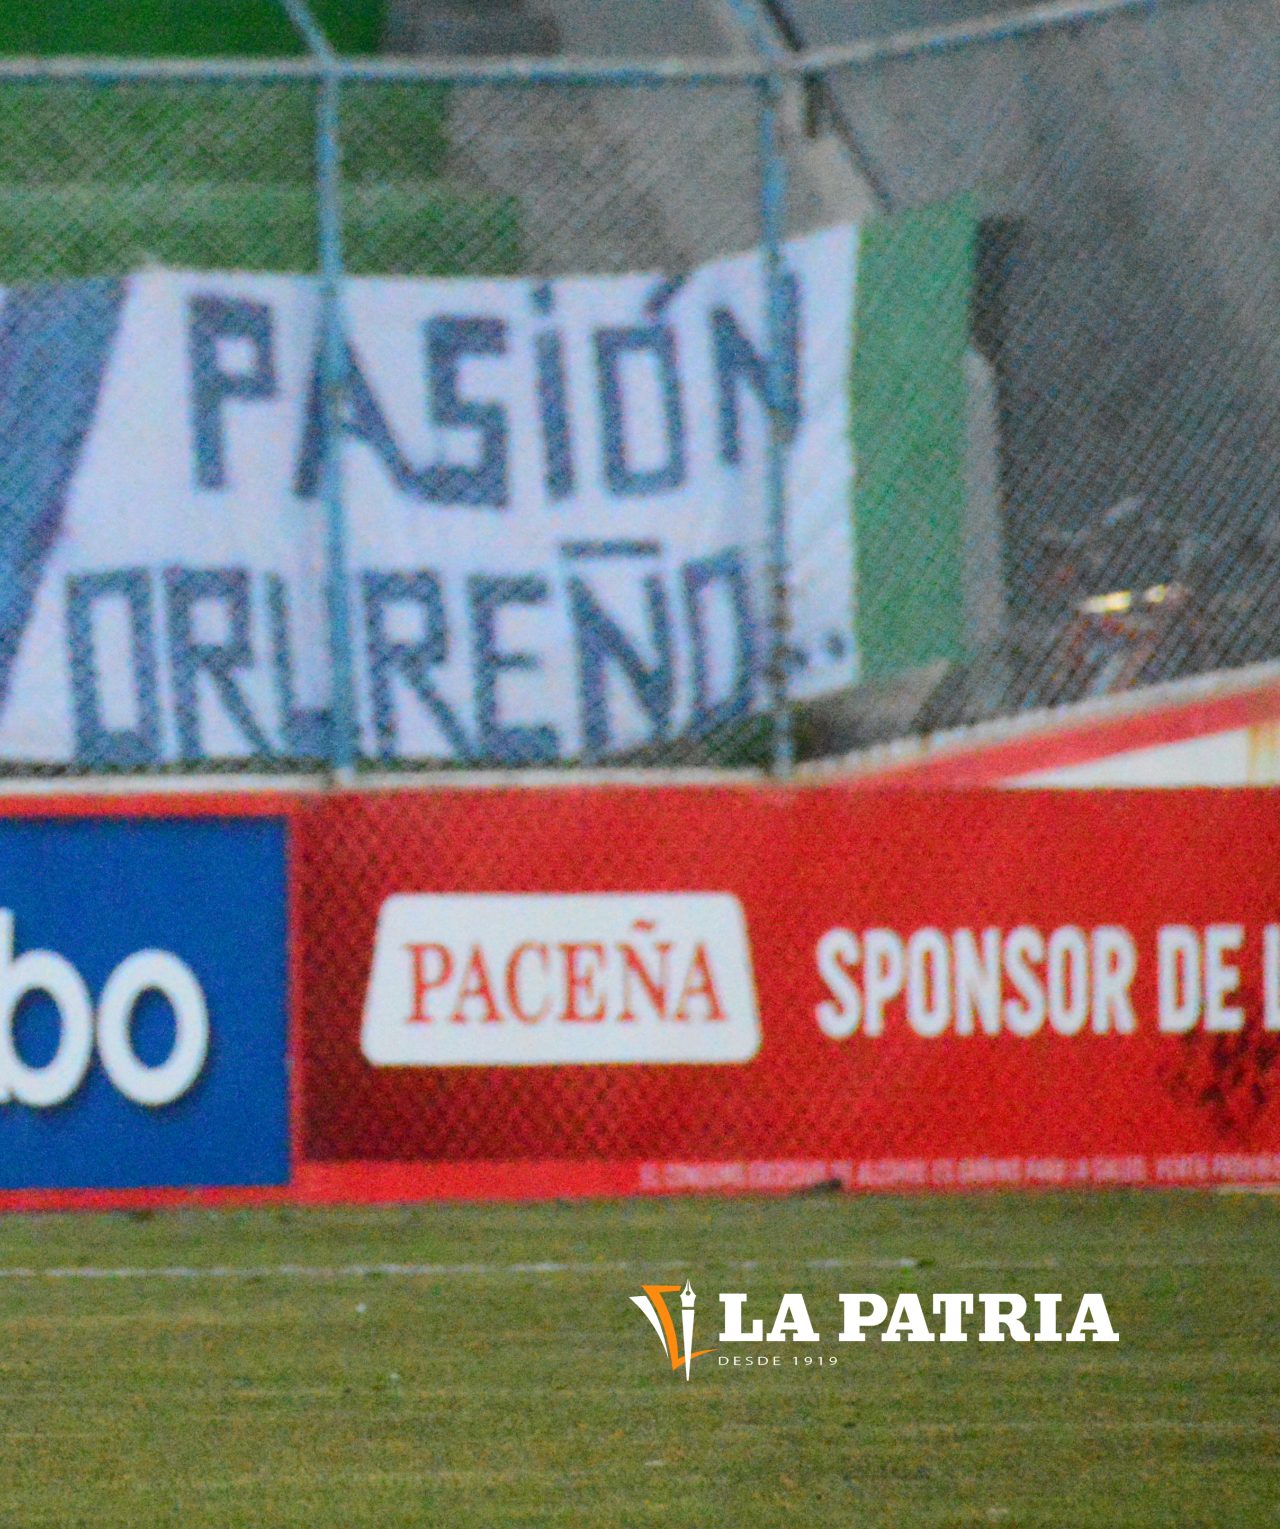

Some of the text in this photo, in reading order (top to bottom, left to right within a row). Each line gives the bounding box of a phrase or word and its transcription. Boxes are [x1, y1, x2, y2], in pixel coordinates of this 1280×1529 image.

[188, 270, 804, 509] PASIÓN
[405, 919, 730, 1024] PACEÑA
[814, 924, 1136, 1039] SPONSOR
[1157, 922, 1245, 1034] DE
